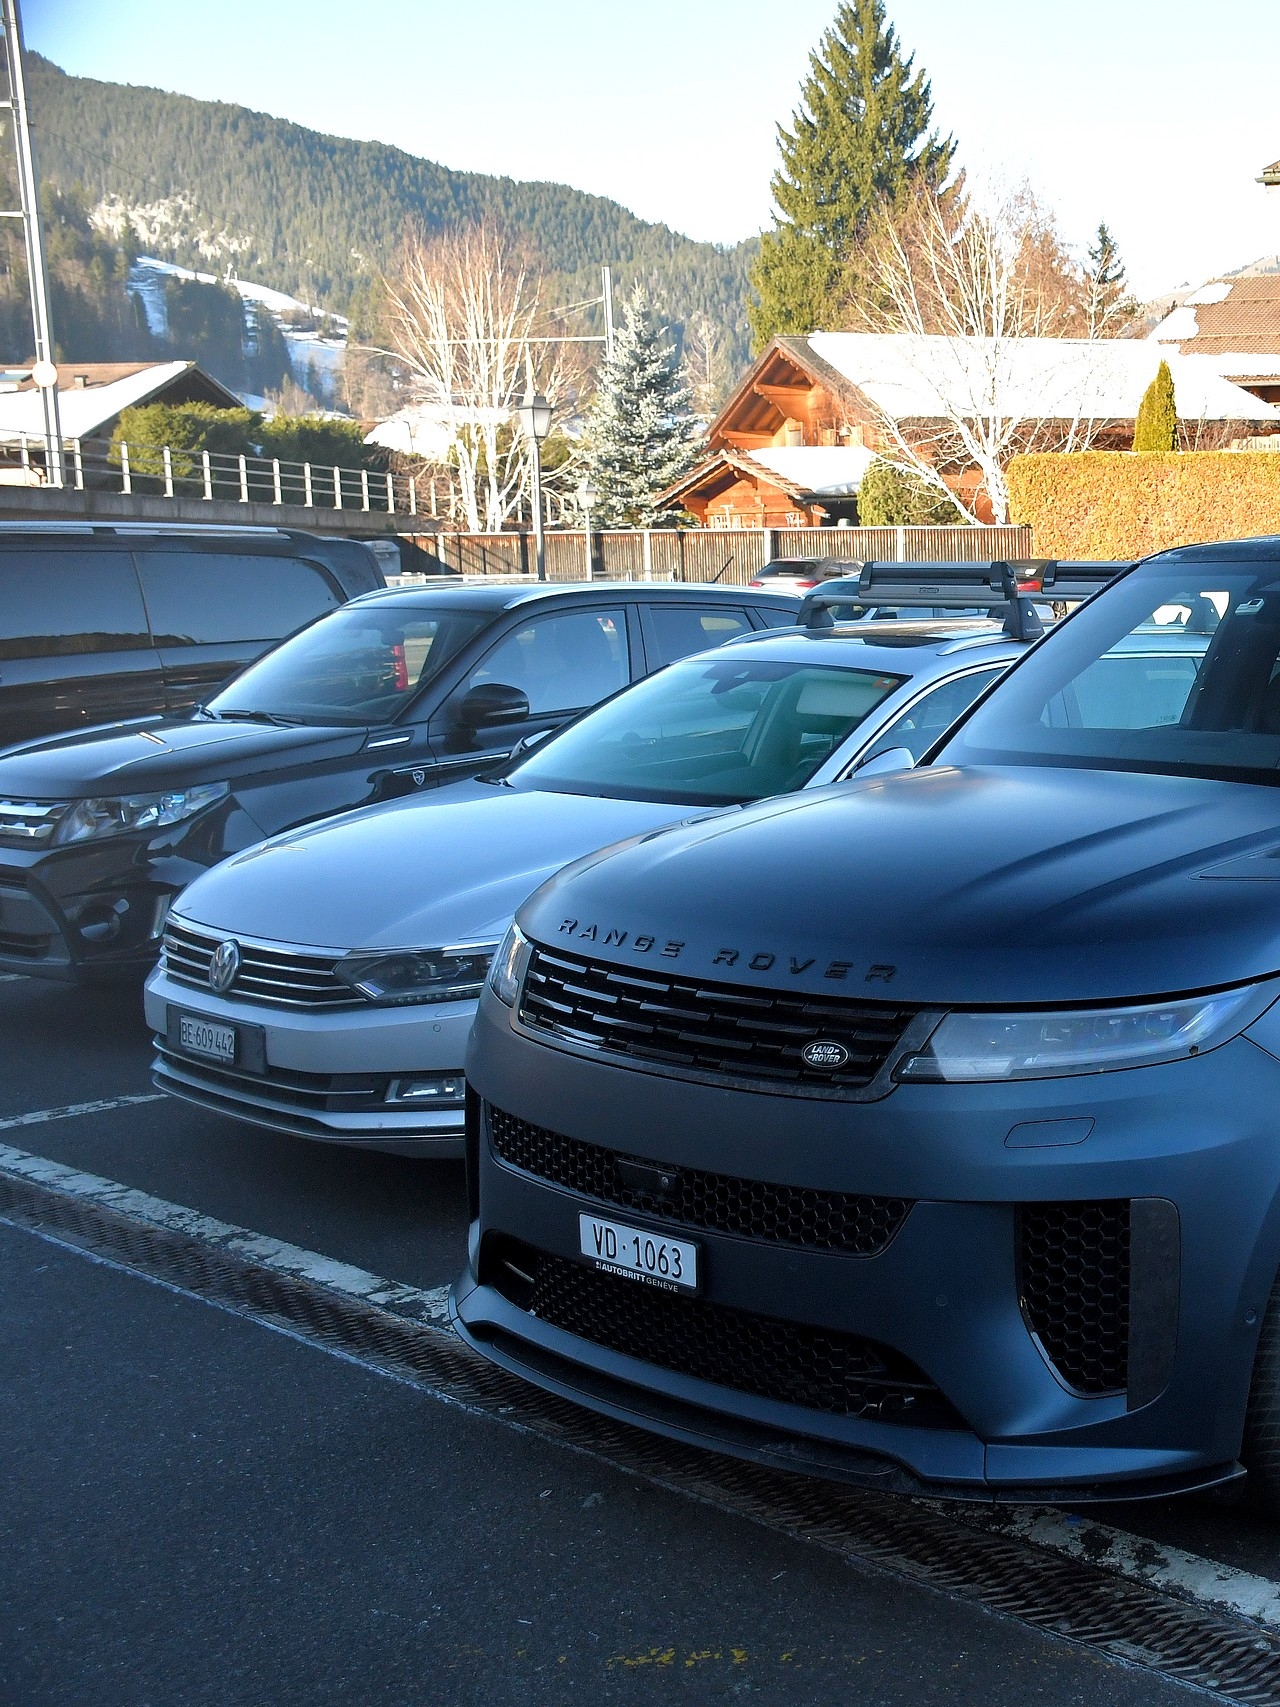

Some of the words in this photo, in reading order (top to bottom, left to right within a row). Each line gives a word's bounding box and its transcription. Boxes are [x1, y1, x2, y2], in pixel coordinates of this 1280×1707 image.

[558, 918, 685, 957] RANGE
[712, 949, 898, 983] ROVER
[811, 1045, 835, 1054] LAND
[811, 1053, 841, 1063] ROVER
[601, 1263, 646, 1282] AUTOBRITT
